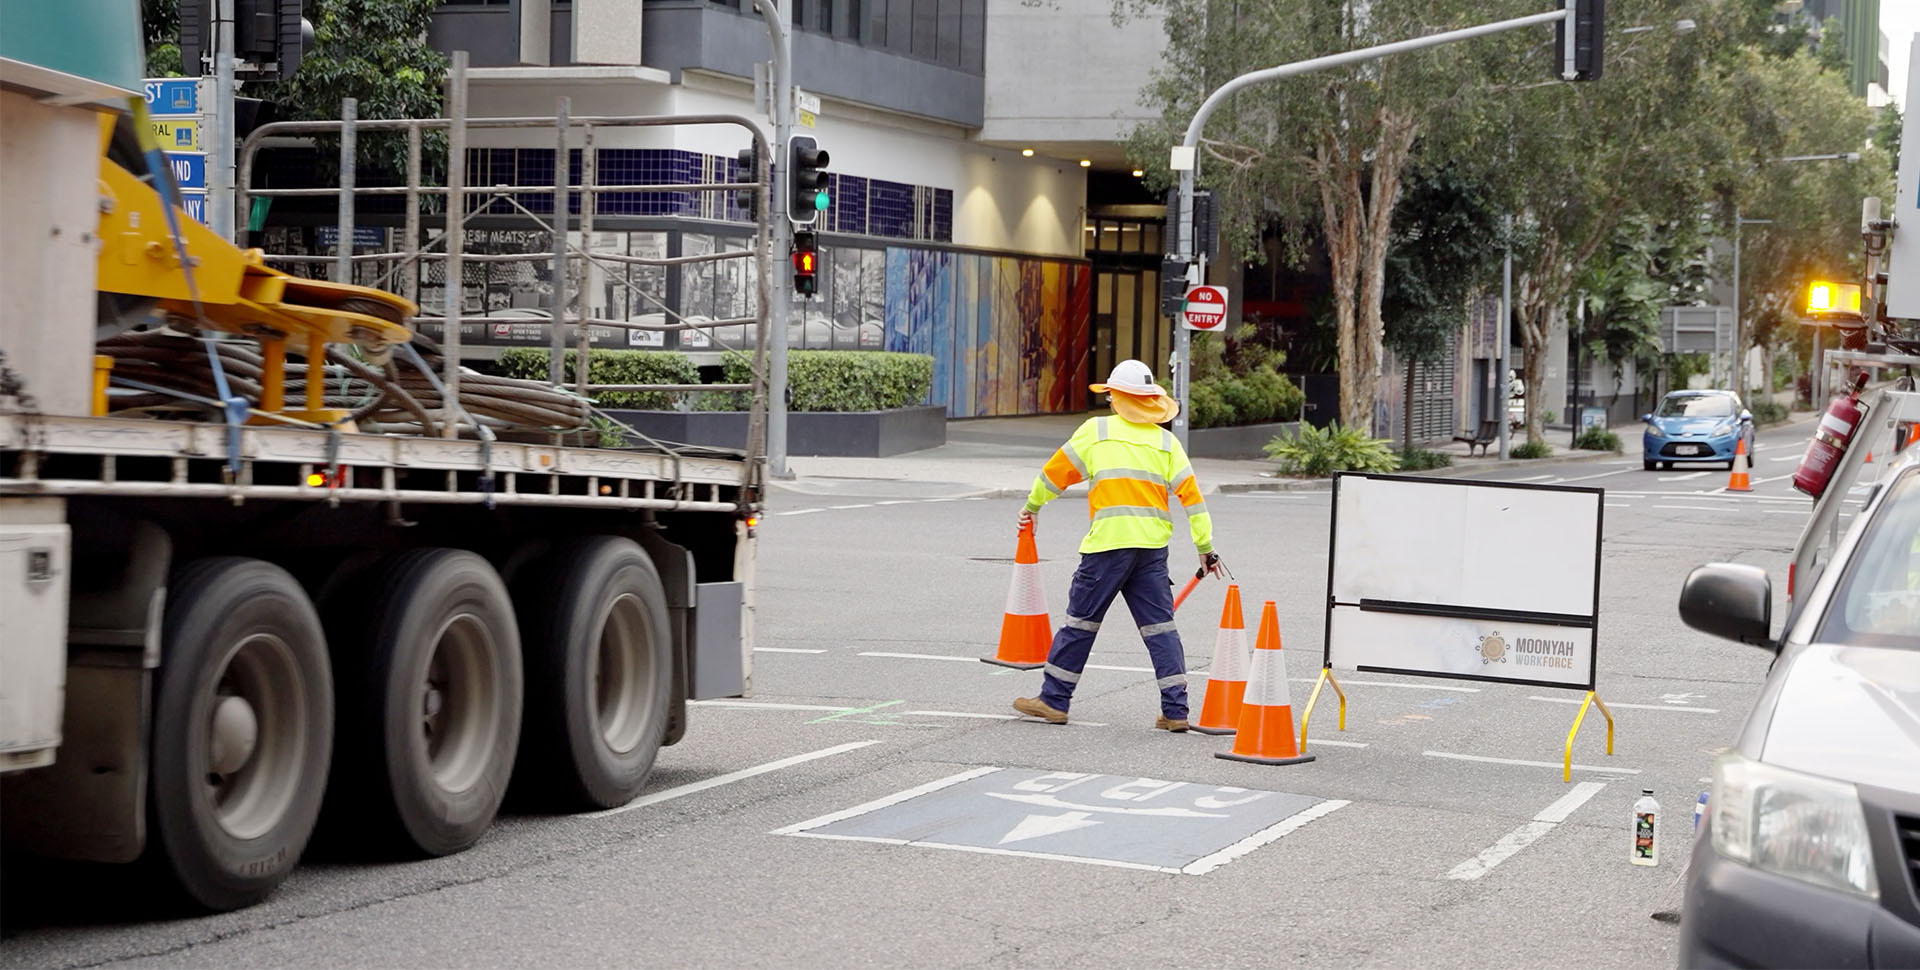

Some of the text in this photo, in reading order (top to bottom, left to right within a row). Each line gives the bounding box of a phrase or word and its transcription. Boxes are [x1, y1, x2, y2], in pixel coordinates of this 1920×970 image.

[144, 82, 164, 104] ST
[462, 229, 488, 241] RESH
[1198, 291, 1213, 302] NO
[1188, 313, 1221, 324] ENTRY
[1515, 637, 1575, 657] MOONYAH
[1515, 653, 1573, 669] WORKFORCE
